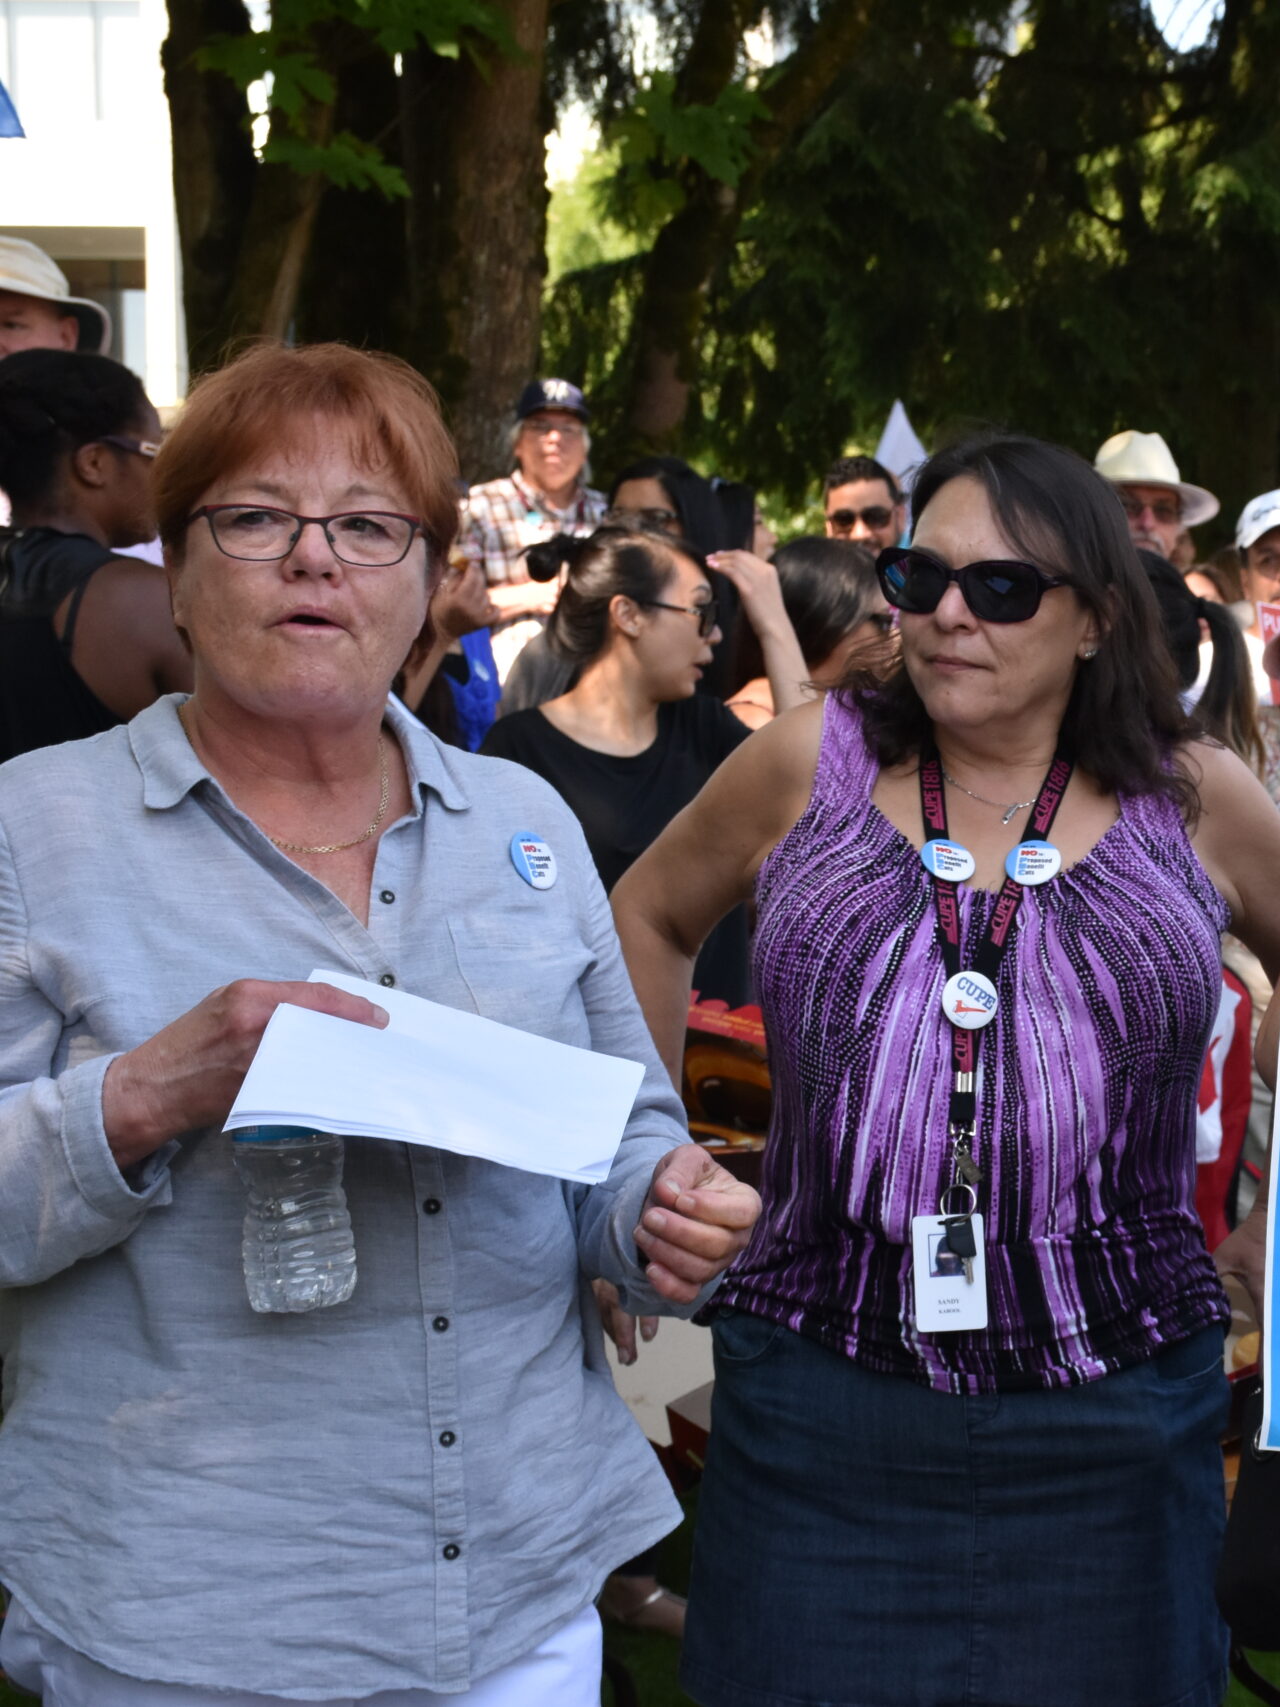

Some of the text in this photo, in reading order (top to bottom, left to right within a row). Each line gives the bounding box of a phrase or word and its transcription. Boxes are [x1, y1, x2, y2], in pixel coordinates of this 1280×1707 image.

[922, 760, 941, 820] CUPE 1816
[1034, 758, 1071, 818] CUPE 1816
[938, 894, 952, 930] CUPE
[990, 895, 1012, 931] CUPE
[957, 976, 997, 1011] CUPE
